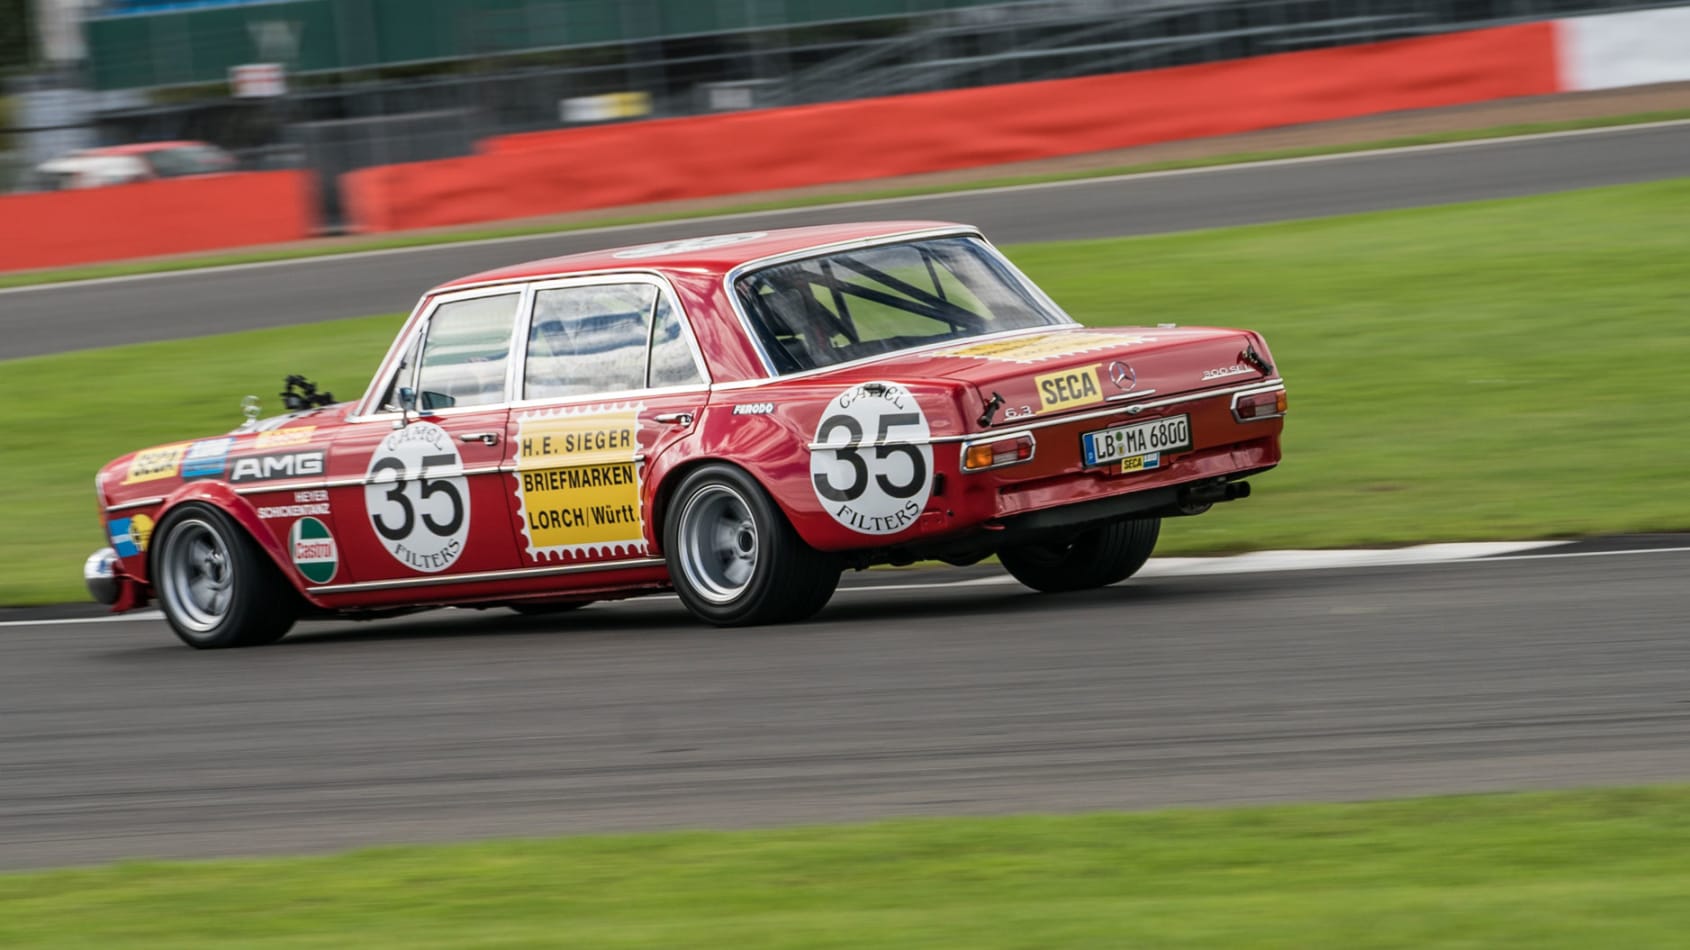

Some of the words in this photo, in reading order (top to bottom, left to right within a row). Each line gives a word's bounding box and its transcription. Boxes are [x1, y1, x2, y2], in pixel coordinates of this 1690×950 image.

[1041, 372, 1097, 405] SECA
[733, 402, 774, 415] FERODO
[387, 425, 443, 452] CAMEL
[523, 436, 558, 457] H.E.
[566, 429, 631, 452] SIEGER
[1095, 434, 1115, 459] LB
[1126, 428, 1147, 453] MA
[1150, 420, 1186, 448] 6800
[231, 452, 323, 481] AMG
[813, 412, 927, 502] 35
[1123, 457, 1143, 470] SECA
[524, 466, 634, 493] BRIEFMARKEN
[371, 453, 464, 541] 35
[836, 500, 920, 532] FILTERS
[295, 541, 333, 560] Castrol
[394, 538, 460, 570] FILTERS
